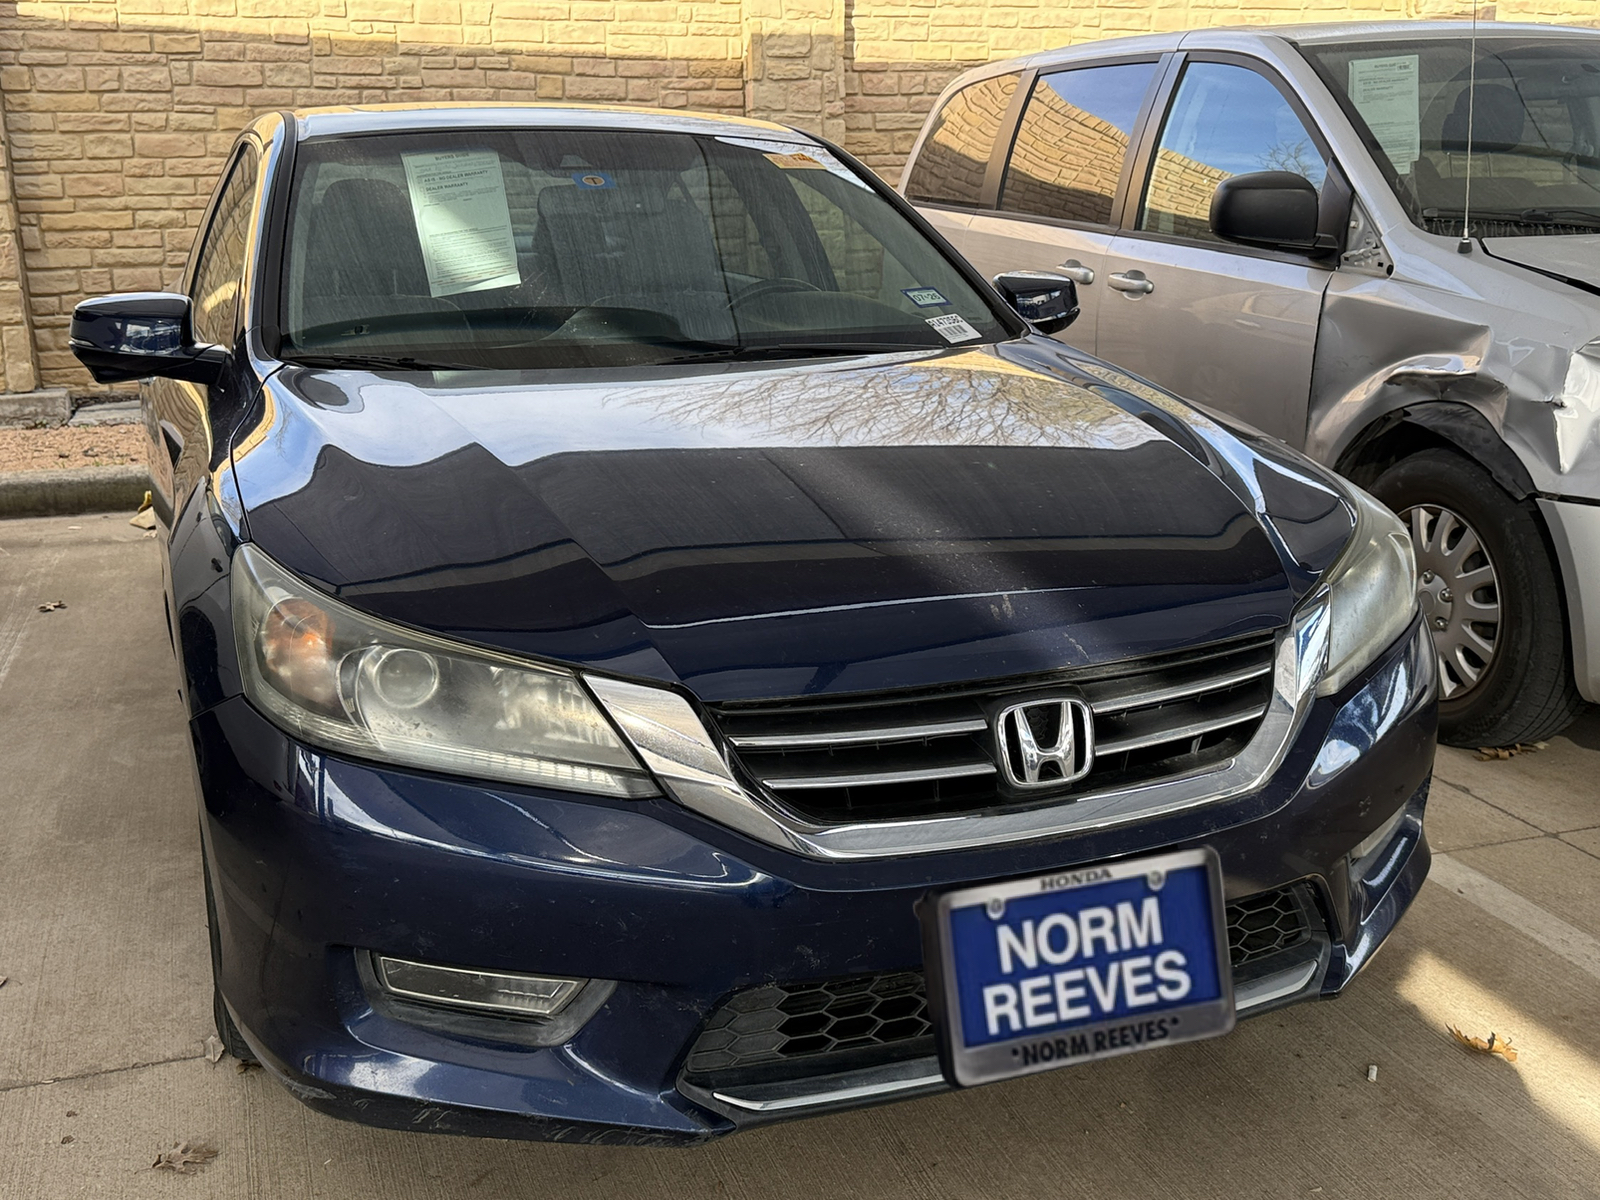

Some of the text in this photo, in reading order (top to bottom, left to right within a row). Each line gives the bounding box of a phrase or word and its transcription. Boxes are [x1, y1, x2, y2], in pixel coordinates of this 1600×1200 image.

[1041, 868, 1112, 890] HONDA
[996, 896, 1163, 974] NORM
[982, 950, 1192, 1036] REEVES
